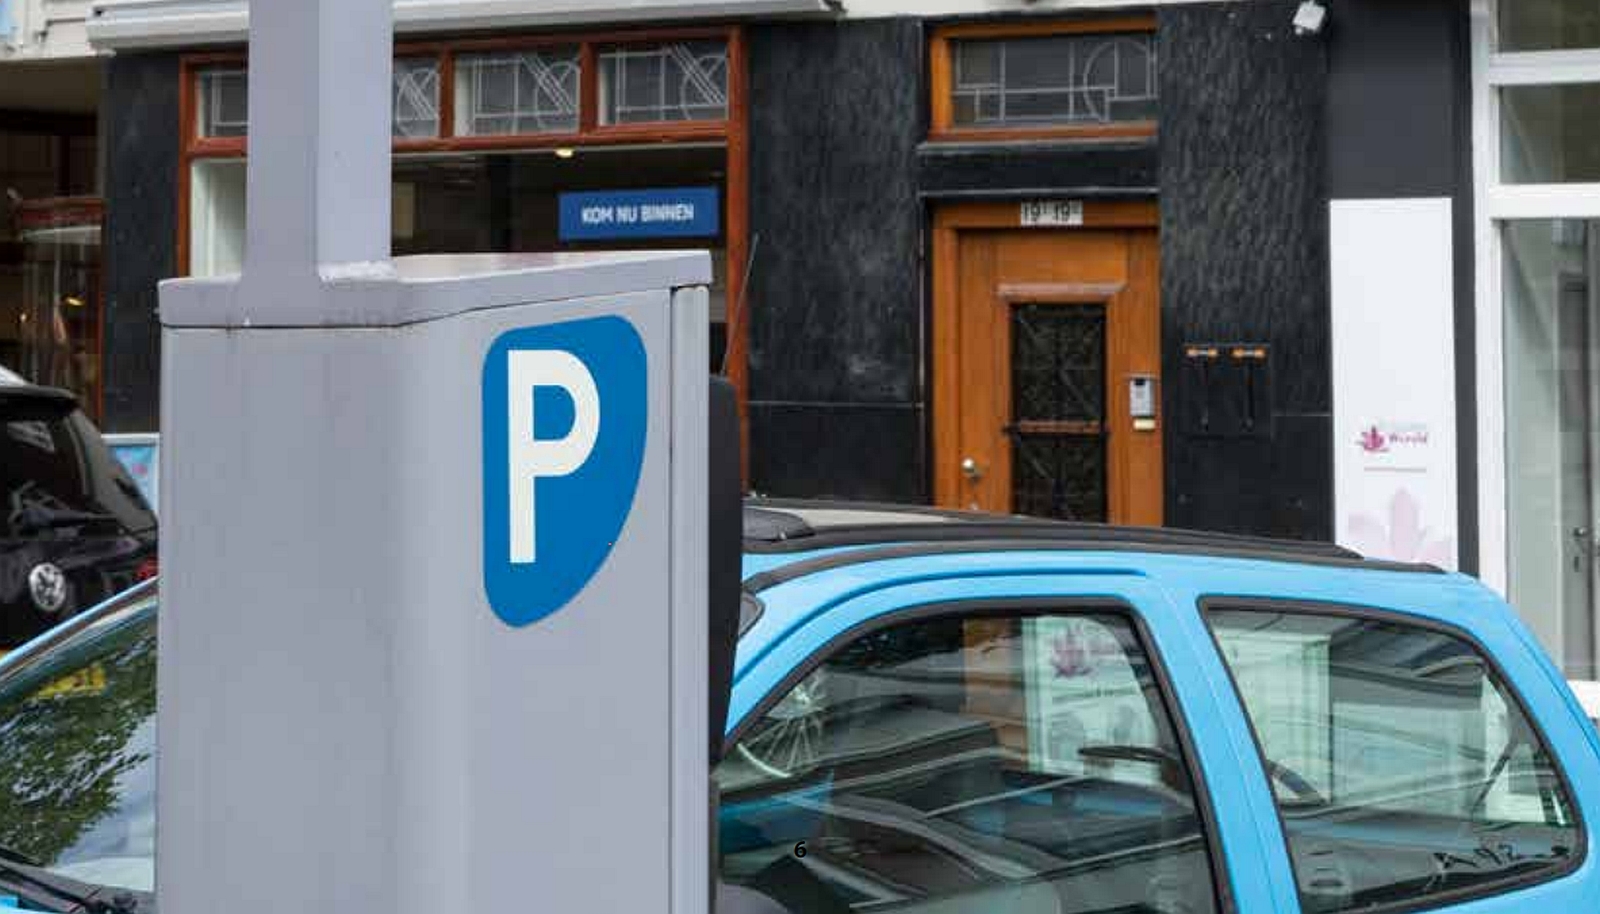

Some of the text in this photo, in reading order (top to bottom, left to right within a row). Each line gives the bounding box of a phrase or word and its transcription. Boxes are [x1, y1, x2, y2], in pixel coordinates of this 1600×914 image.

[582, 203, 694, 223] KOM NU BINNEN
[507, 349, 600, 563] P
